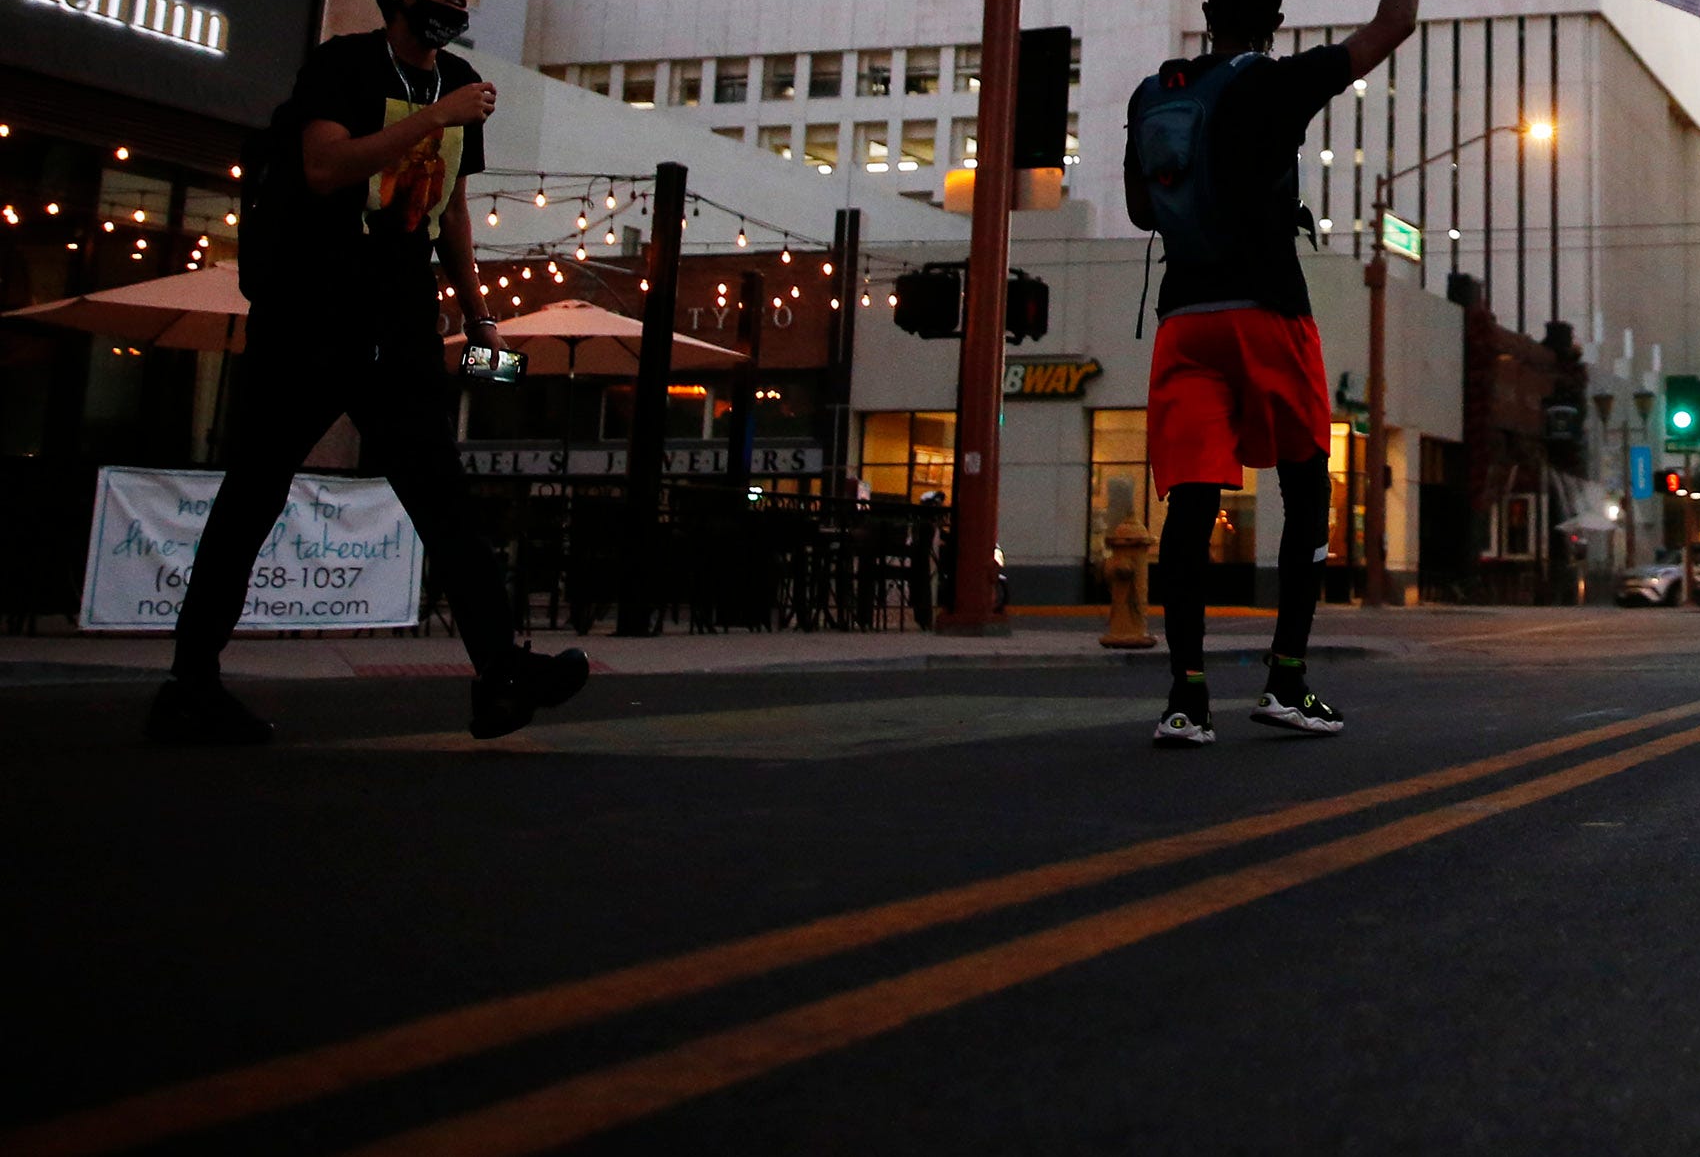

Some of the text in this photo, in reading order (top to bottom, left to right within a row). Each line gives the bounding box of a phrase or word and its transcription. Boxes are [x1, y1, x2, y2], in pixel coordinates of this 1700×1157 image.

[309, 485, 351, 522] for
[292, 520, 400, 560] takeout!
[246, 566, 363, 589] 58-1037
